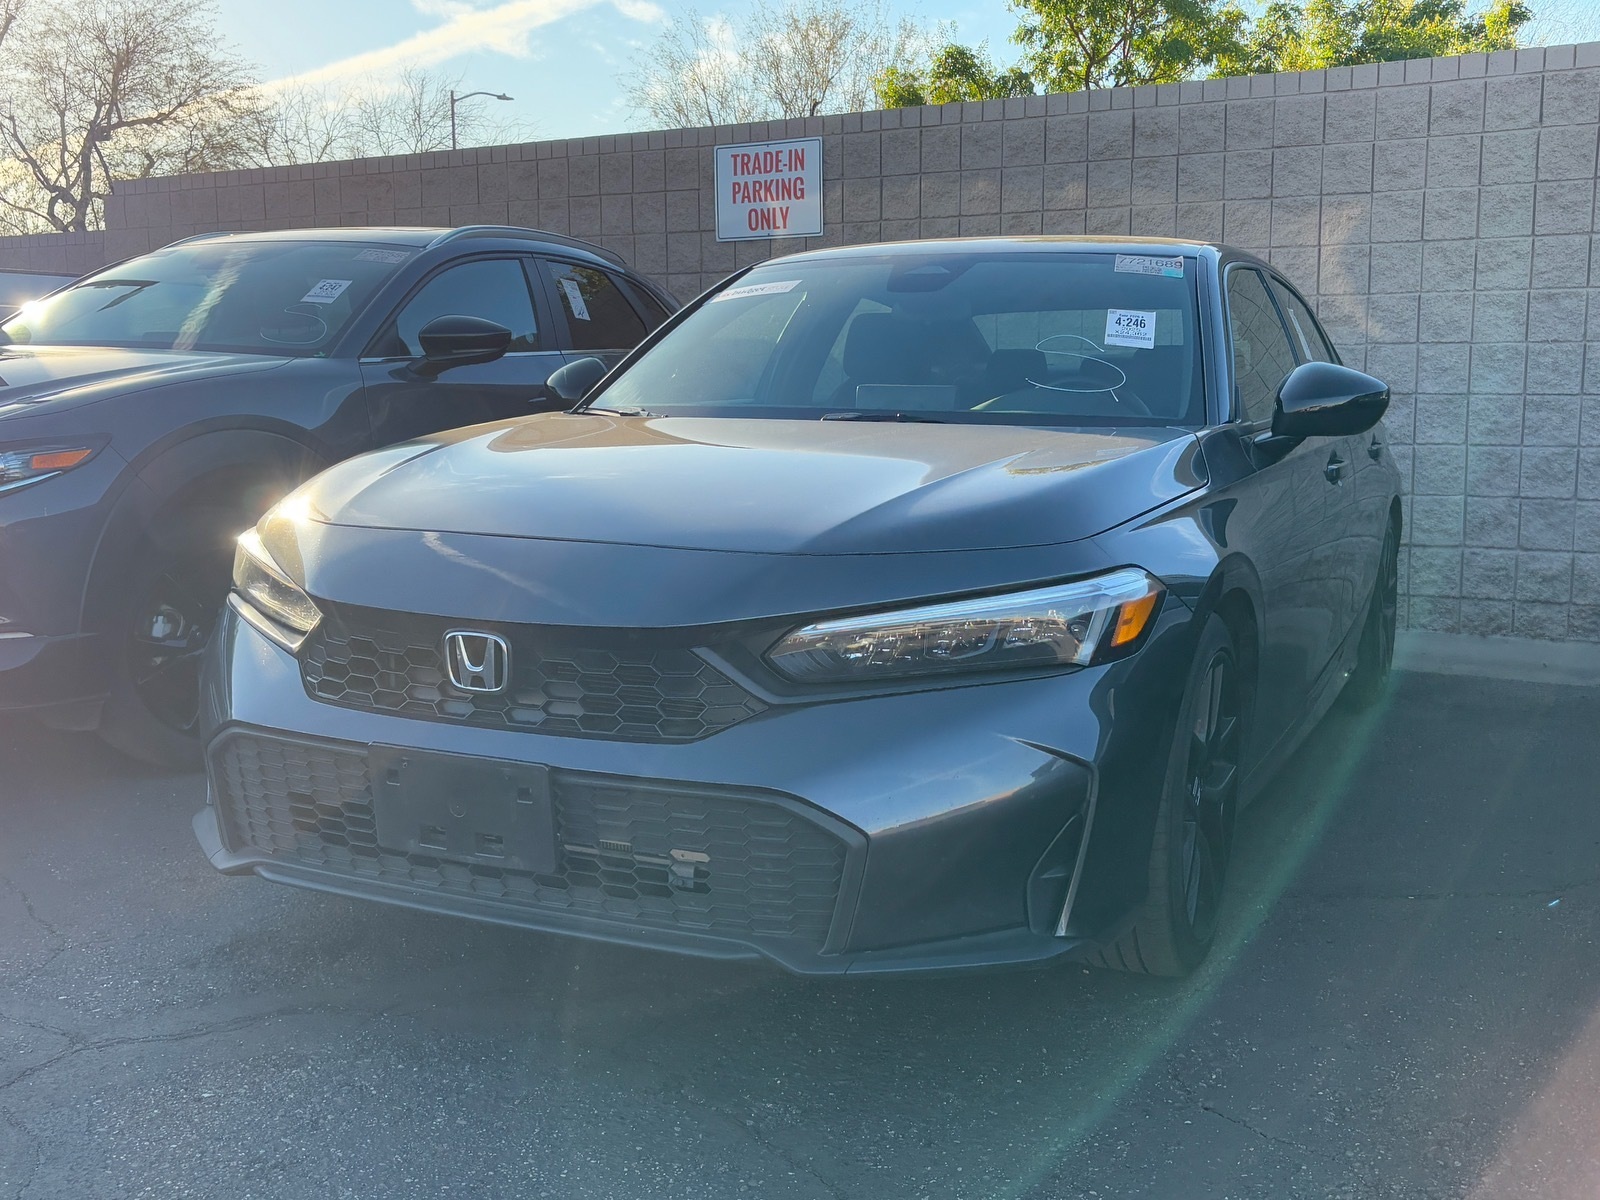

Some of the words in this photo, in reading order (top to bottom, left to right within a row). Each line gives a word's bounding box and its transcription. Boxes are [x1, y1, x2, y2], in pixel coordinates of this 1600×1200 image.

[731, 148, 805, 176] TRADE-IN
[732, 177, 805, 204] PARKING
[748, 206, 790, 231] ONLY
[1119, 257, 1183, 269] 7721689
[1115, 317, 1146, 328] 4:246
